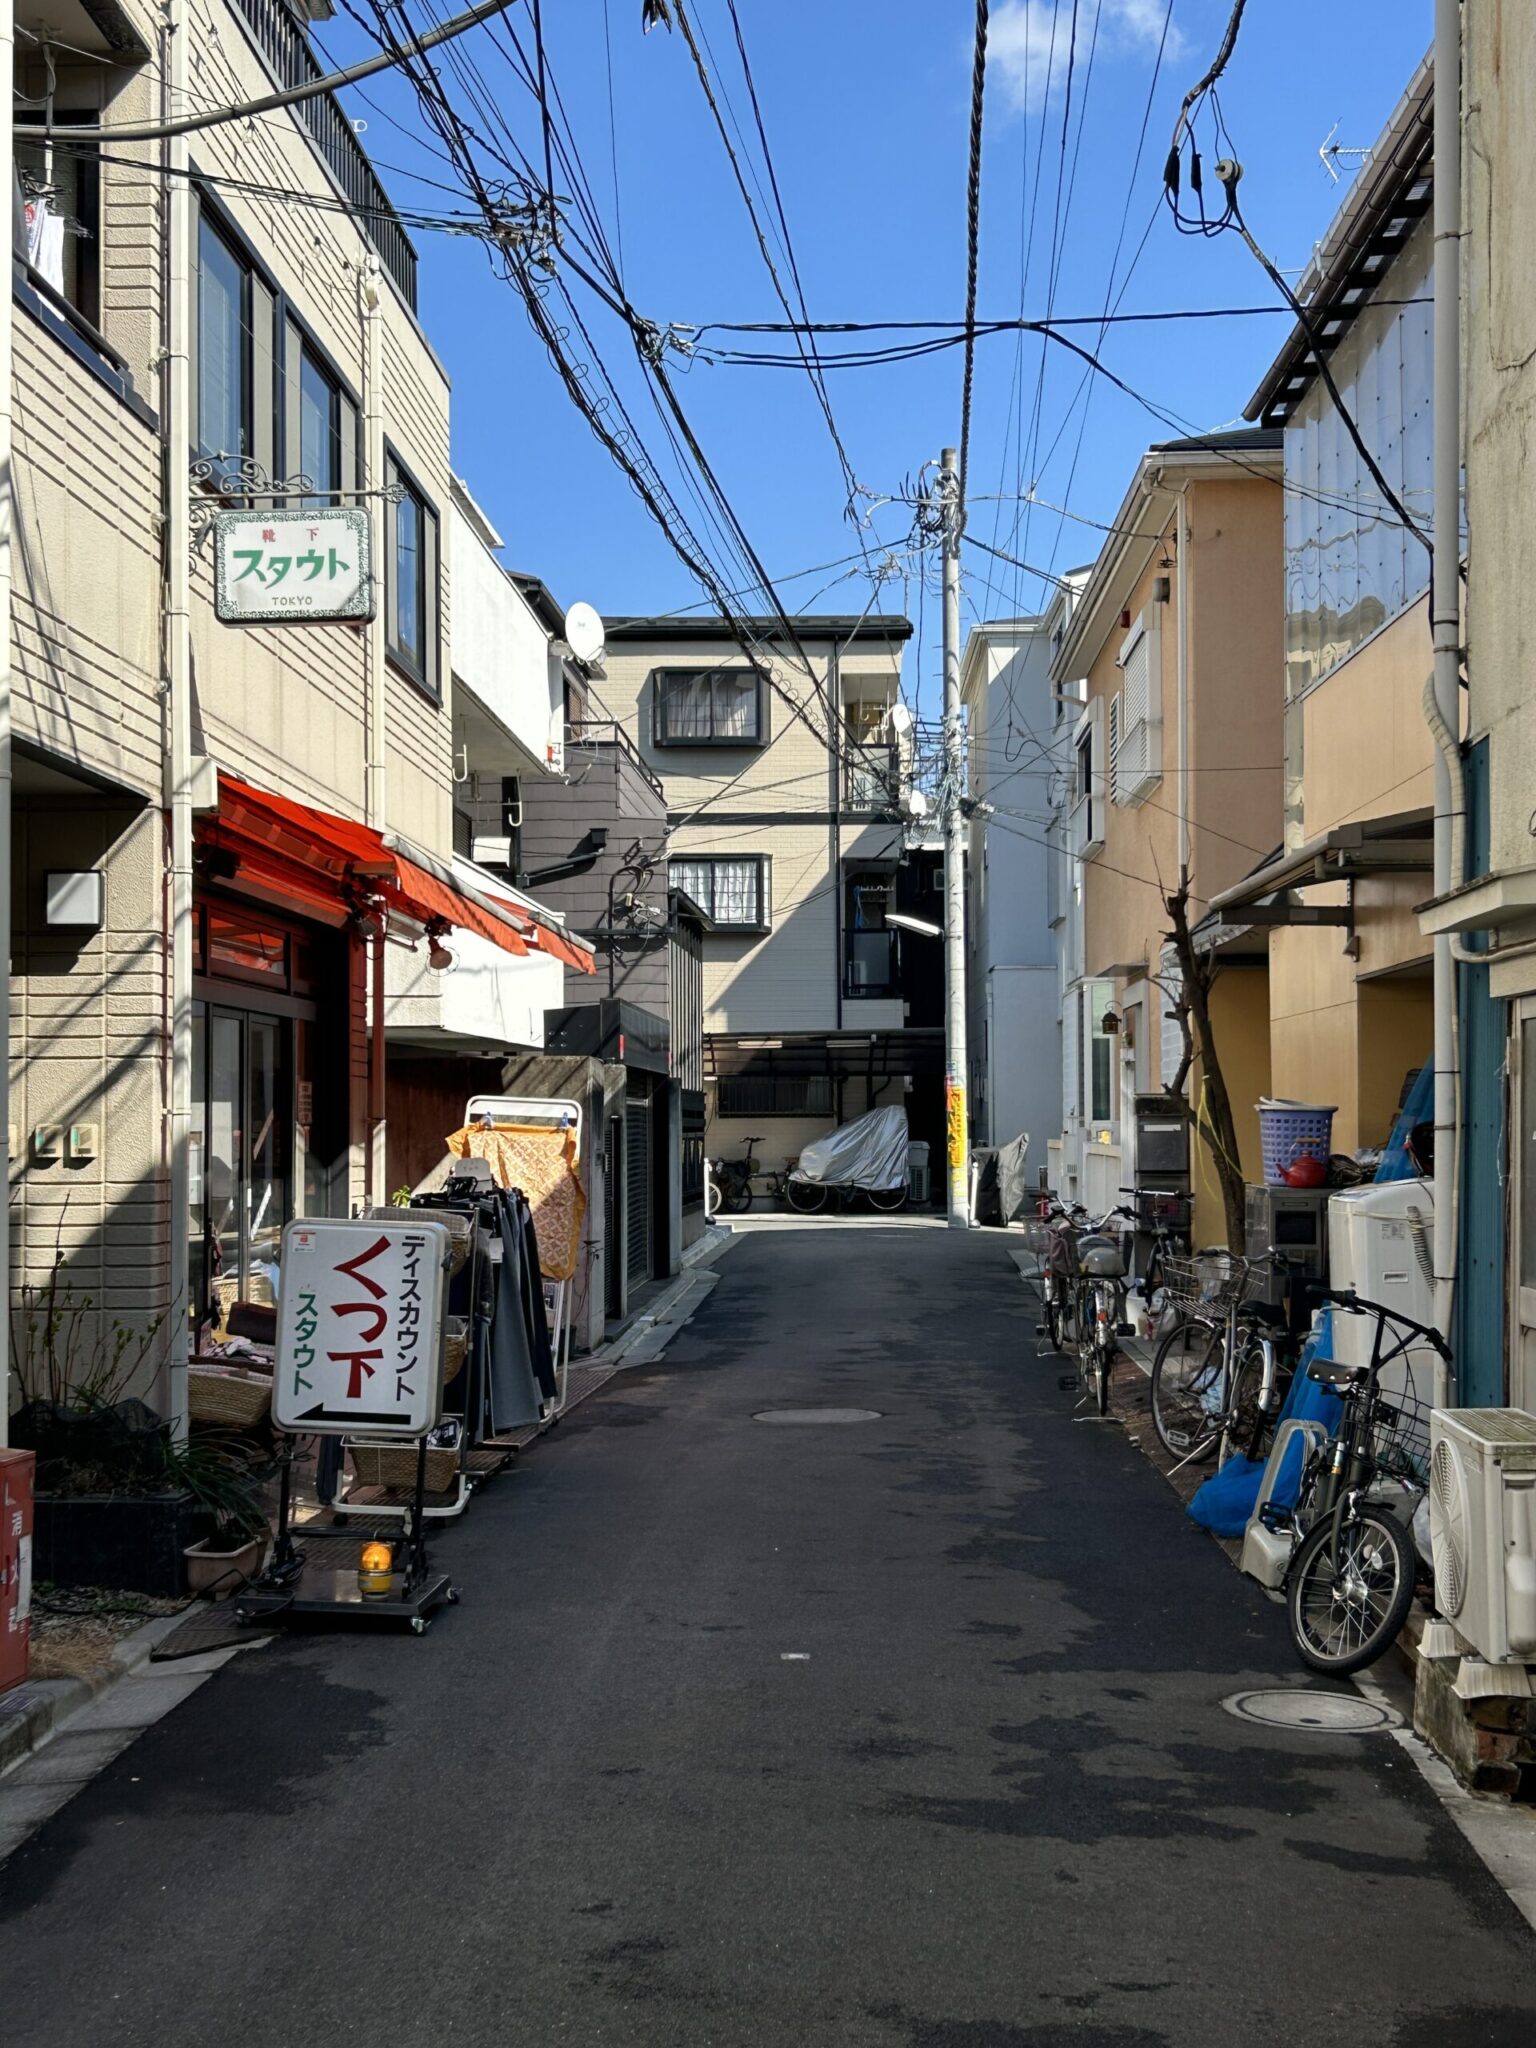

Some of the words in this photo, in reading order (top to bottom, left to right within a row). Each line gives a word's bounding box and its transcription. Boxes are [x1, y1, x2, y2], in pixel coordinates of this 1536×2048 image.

[232, 548, 350, 590] スタウト
[271, 596, 313, 606] TOKYO
[293, 1293, 319, 1396] スタウト
[327, 1235, 392, 1399] くつ下
[396, 1235, 426, 1402] ディスカウント
